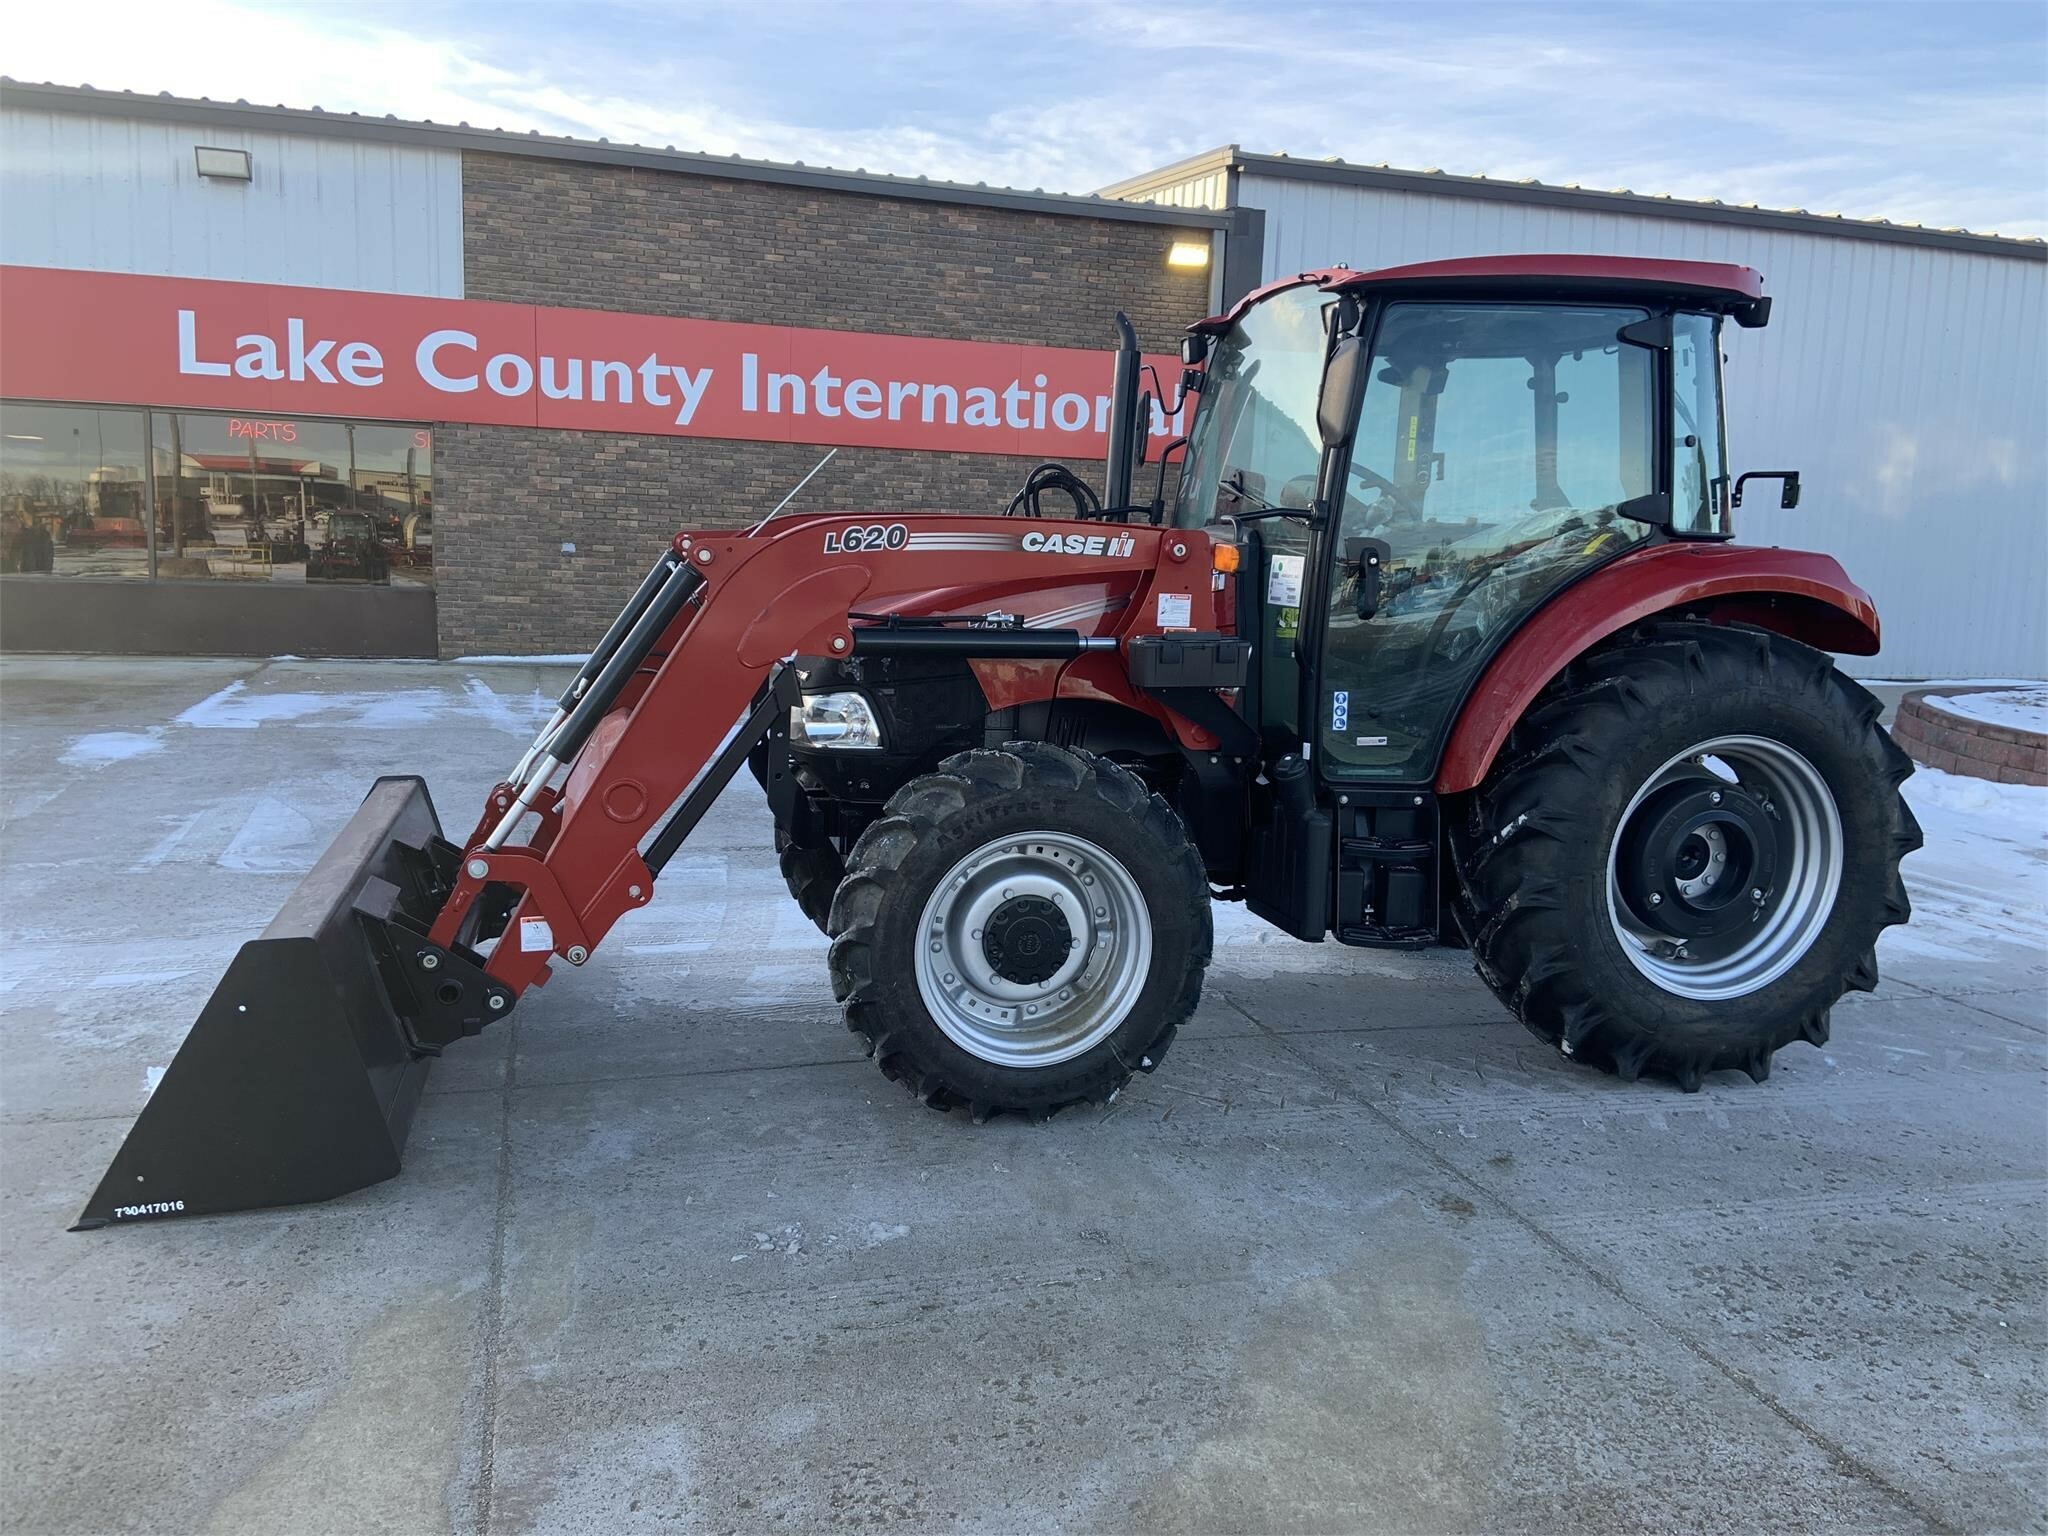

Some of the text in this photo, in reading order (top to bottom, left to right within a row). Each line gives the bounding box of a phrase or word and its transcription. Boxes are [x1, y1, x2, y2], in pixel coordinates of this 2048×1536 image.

[177, 310, 384, 387] Lake
[415, 329, 714, 427] County
[228, 418, 297, 442] PARTS
[413, 431, 432, 449] S
[823, 523, 909, 554] L620
[1021, 531, 1106, 556] CASE
[113, 1200, 185, 1218] 730417016
